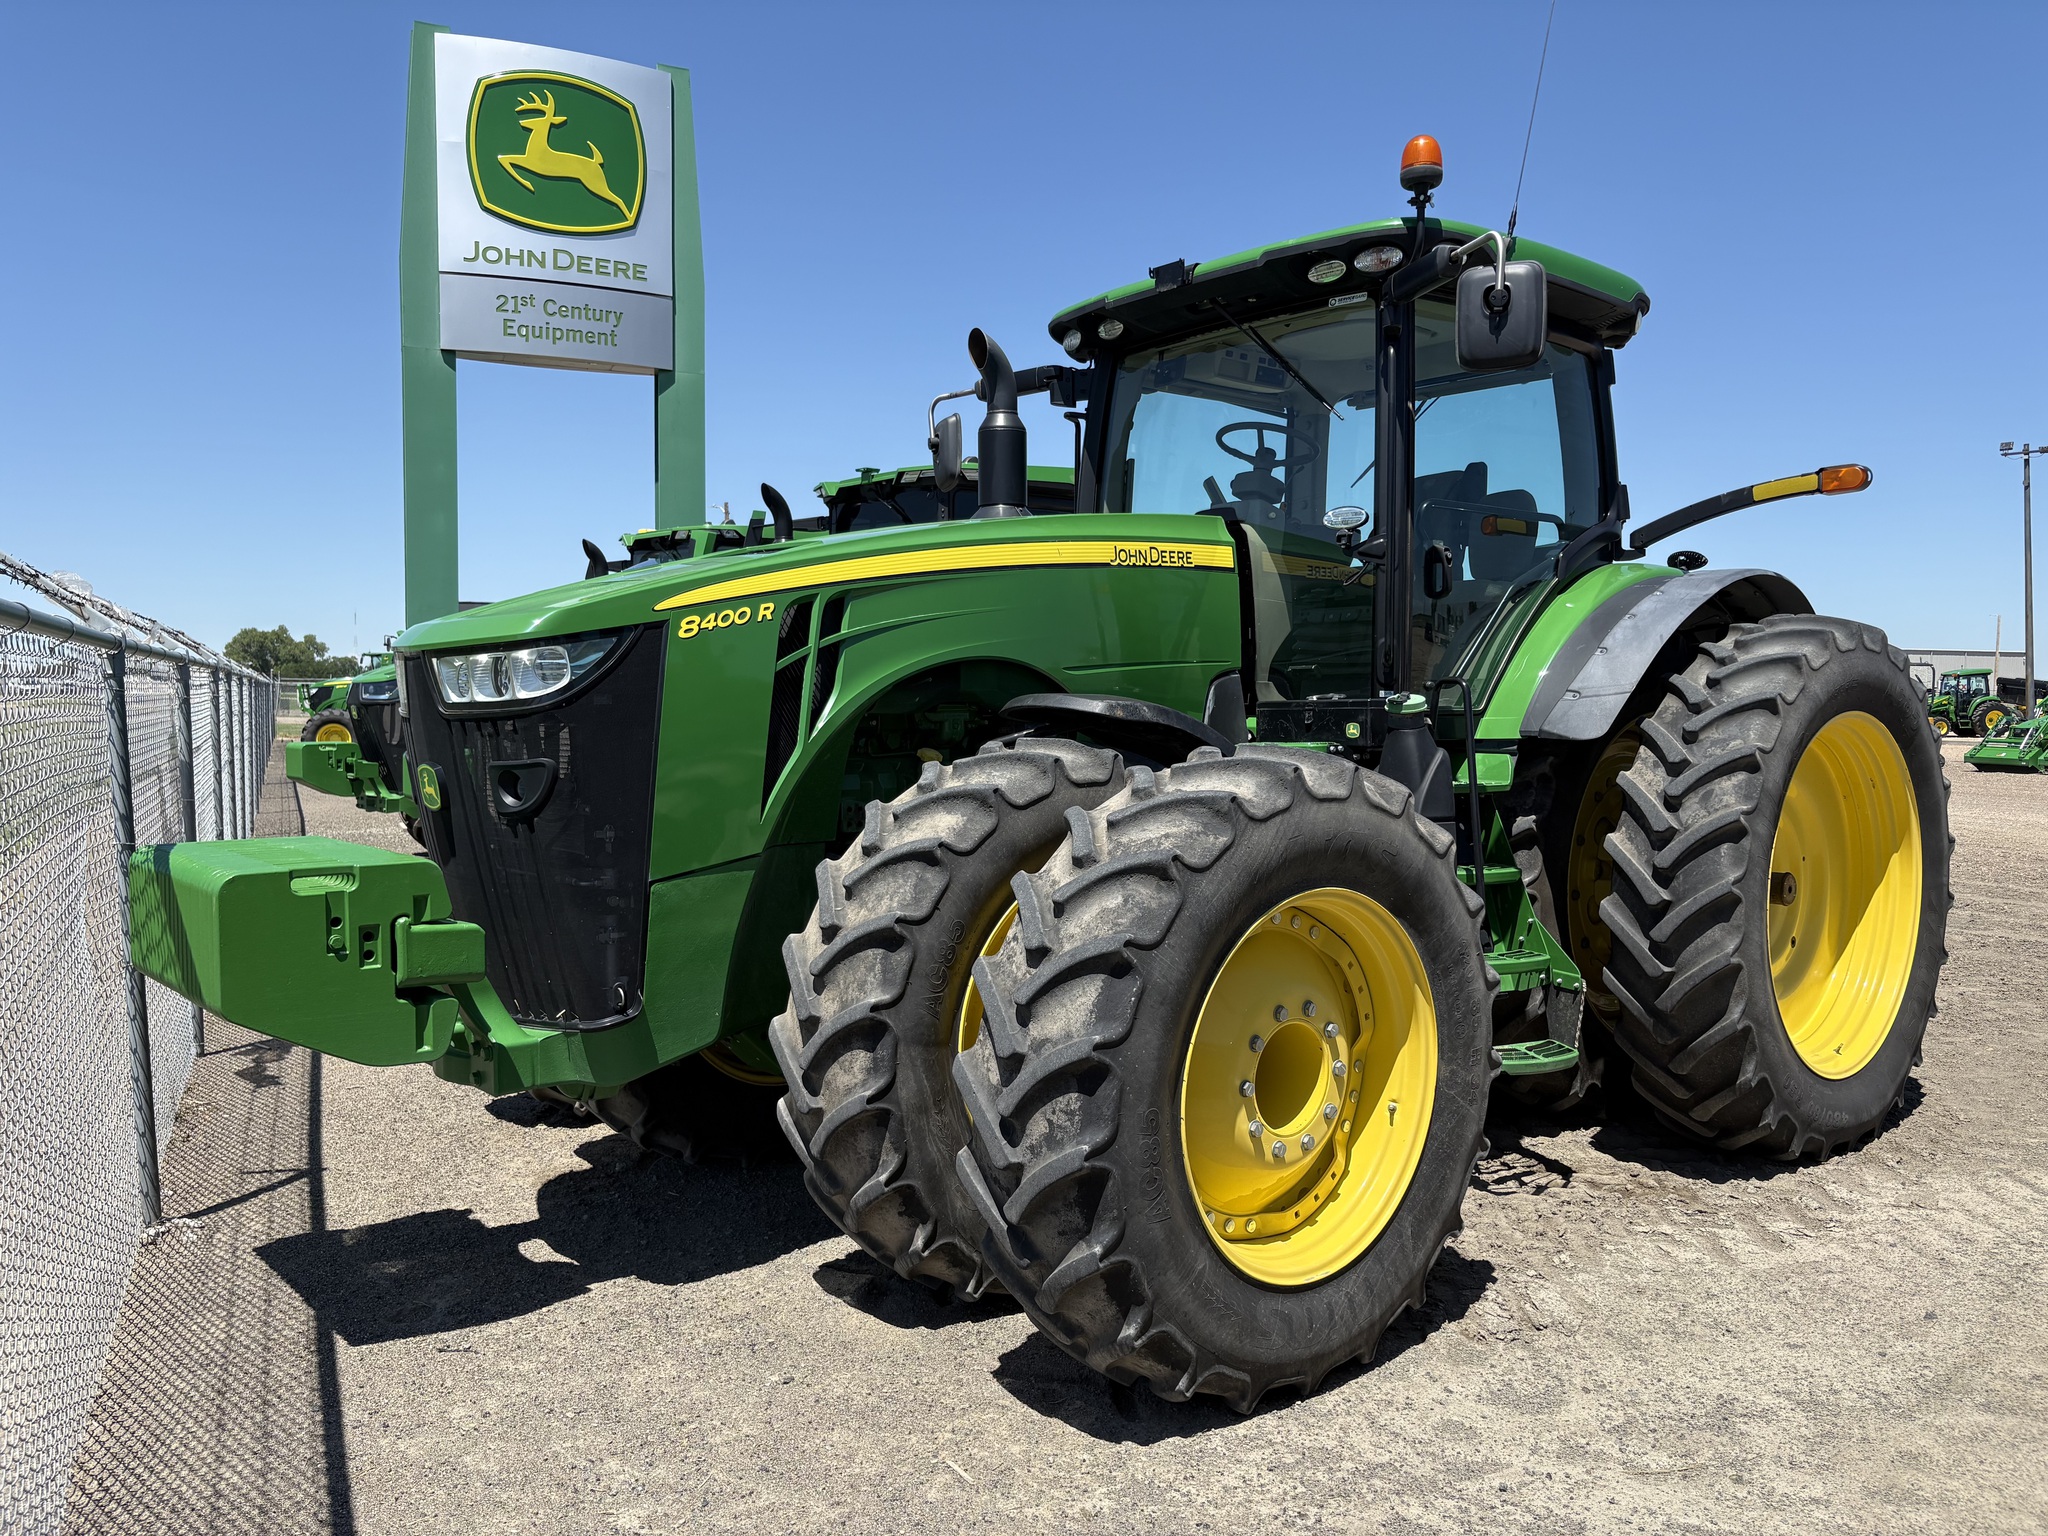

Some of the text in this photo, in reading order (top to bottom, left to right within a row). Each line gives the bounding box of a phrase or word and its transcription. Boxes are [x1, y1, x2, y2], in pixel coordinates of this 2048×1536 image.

[463, 241, 648, 282] JOHN DEERE
[495, 293, 624, 328] 21st Century
[502, 318, 618, 347] Equipment
[1110, 545, 1194, 565] JOHN DEERE
[678, 602, 776, 639] 8400 R
[1138, 1107, 1172, 1225] AC85
